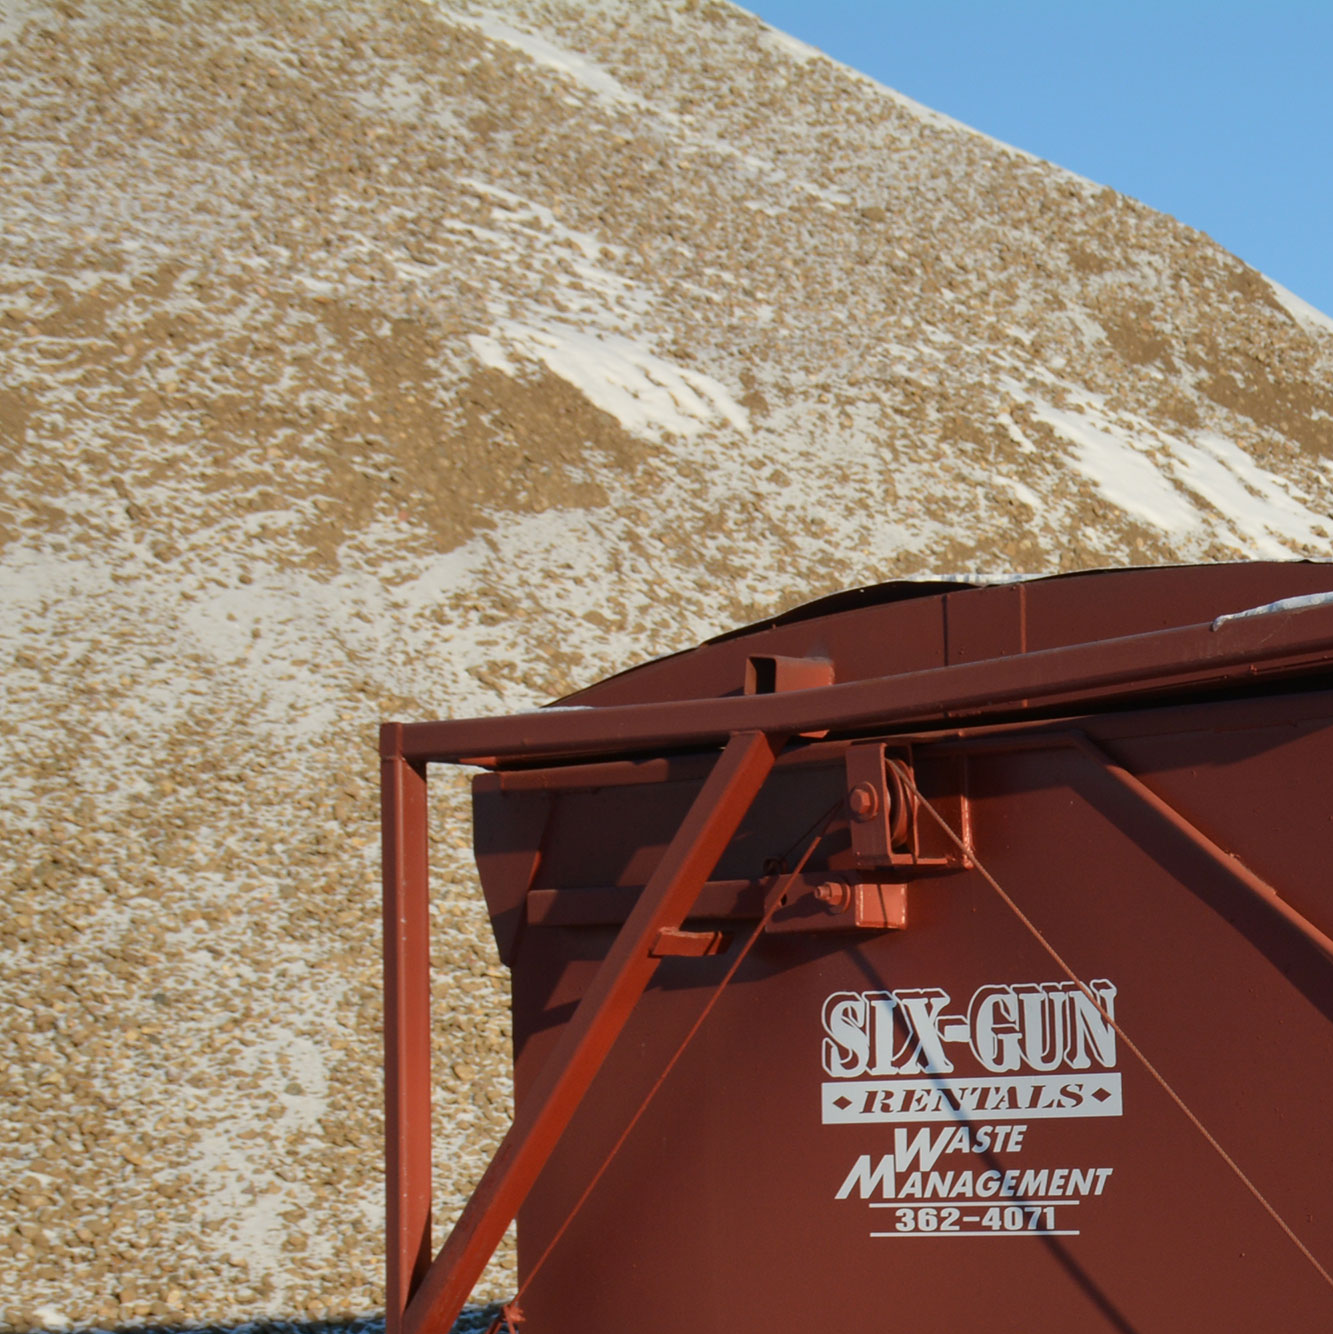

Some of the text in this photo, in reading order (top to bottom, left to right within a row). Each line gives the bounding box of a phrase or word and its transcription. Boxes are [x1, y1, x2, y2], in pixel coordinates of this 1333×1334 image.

[821, 978, 1118, 1077] SIX-GUN
[858, 1083, 1084, 1115] RENTALS
[894, 1124, 1028, 1173] WASTE
[834, 1154, 1114, 1200] MANAGEMENT
[894, 1206, 1056, 1232] 362-4071
